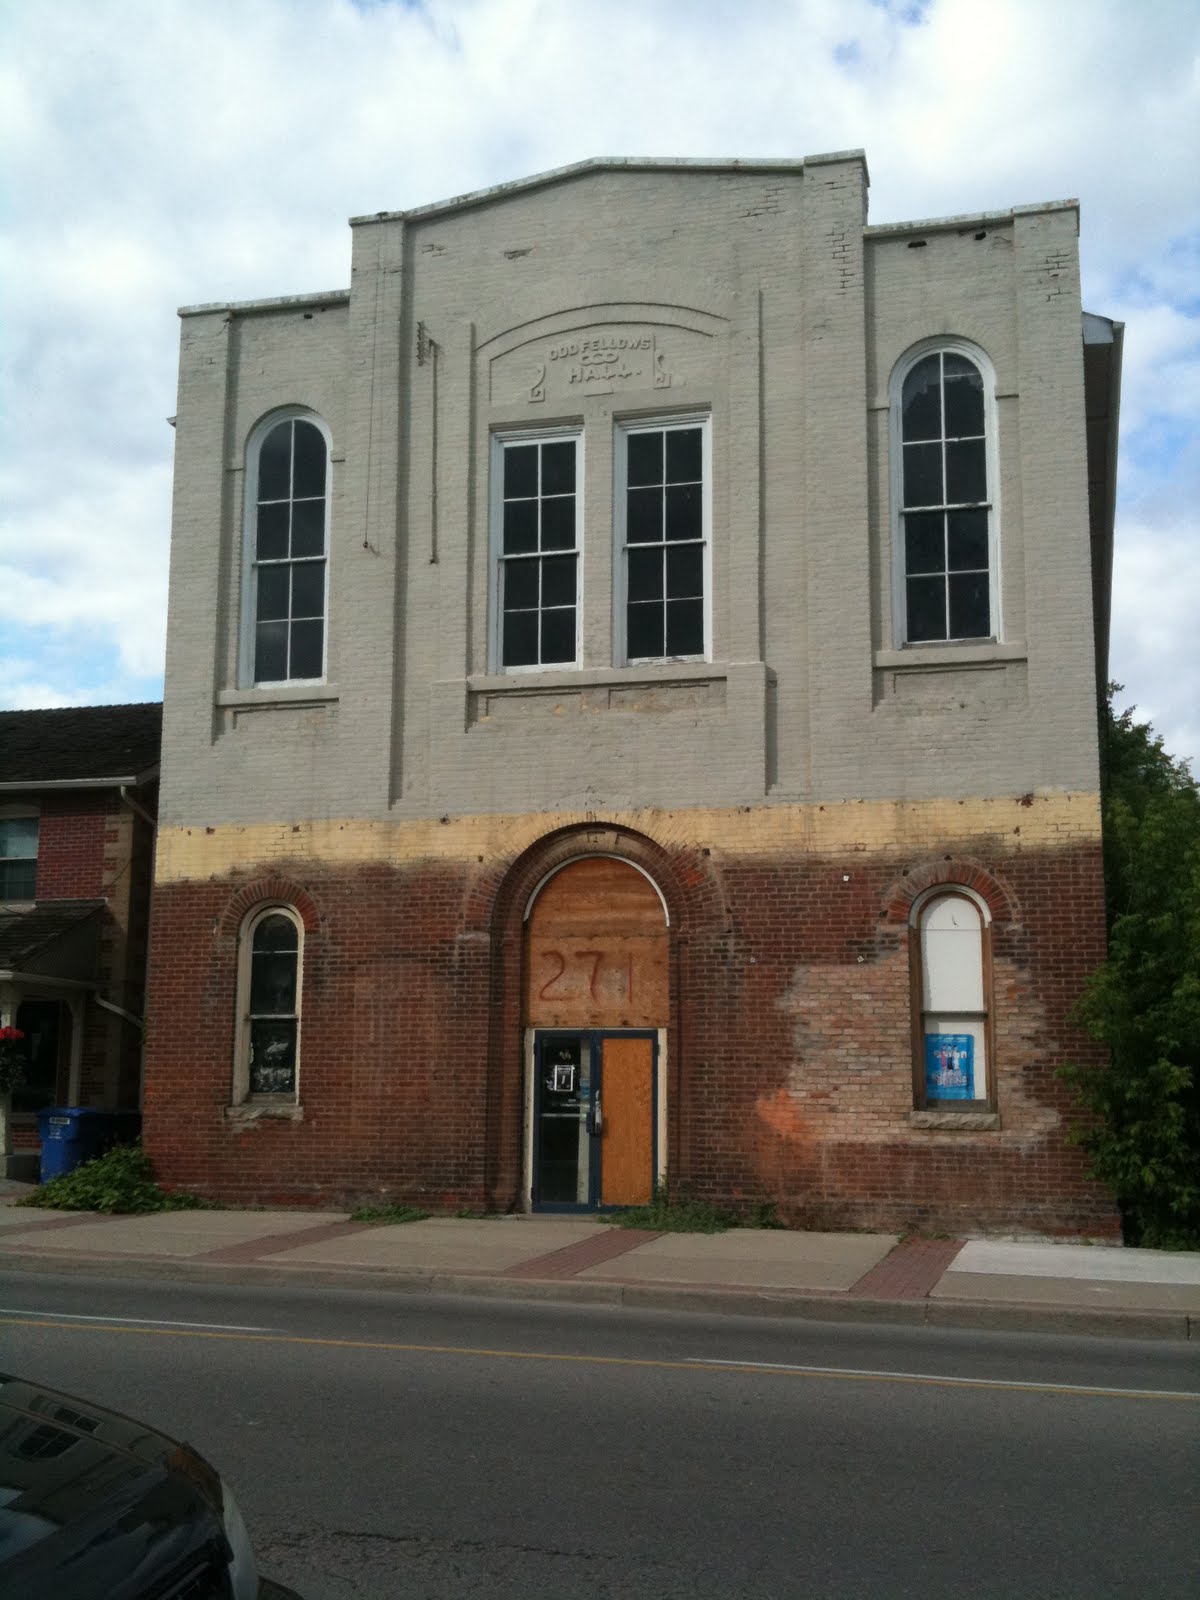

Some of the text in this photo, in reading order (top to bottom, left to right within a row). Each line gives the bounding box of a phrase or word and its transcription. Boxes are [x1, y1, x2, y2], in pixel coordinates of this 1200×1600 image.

[549, 338, 651, 361] ODD FELLOWS
[539, 951, 634, 1006] 271
